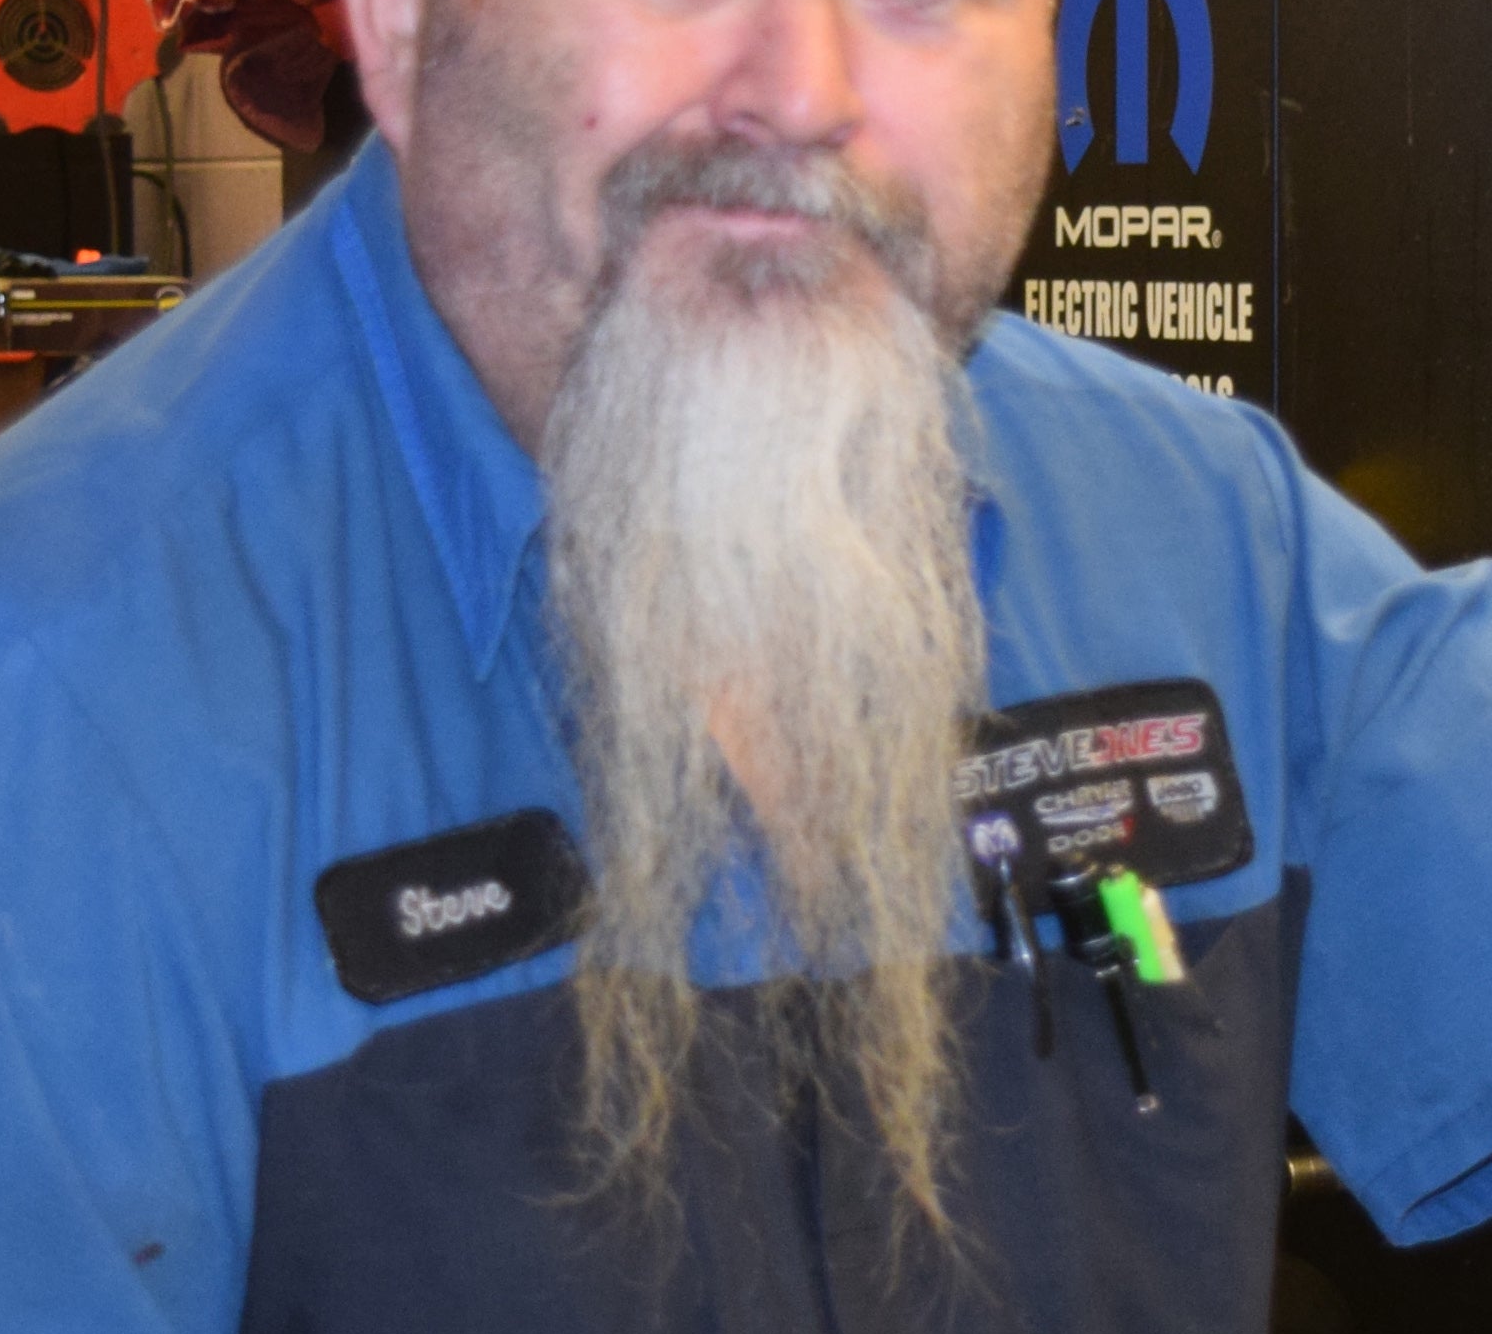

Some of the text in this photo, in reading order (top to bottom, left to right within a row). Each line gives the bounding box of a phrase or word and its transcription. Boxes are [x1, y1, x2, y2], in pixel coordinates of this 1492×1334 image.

[1055, 205, 1212, 249] MOPAR
[1025, 279, 1253, 342] ELECTRIC VEHICLE
[397, 880, 511, 938] Steve
